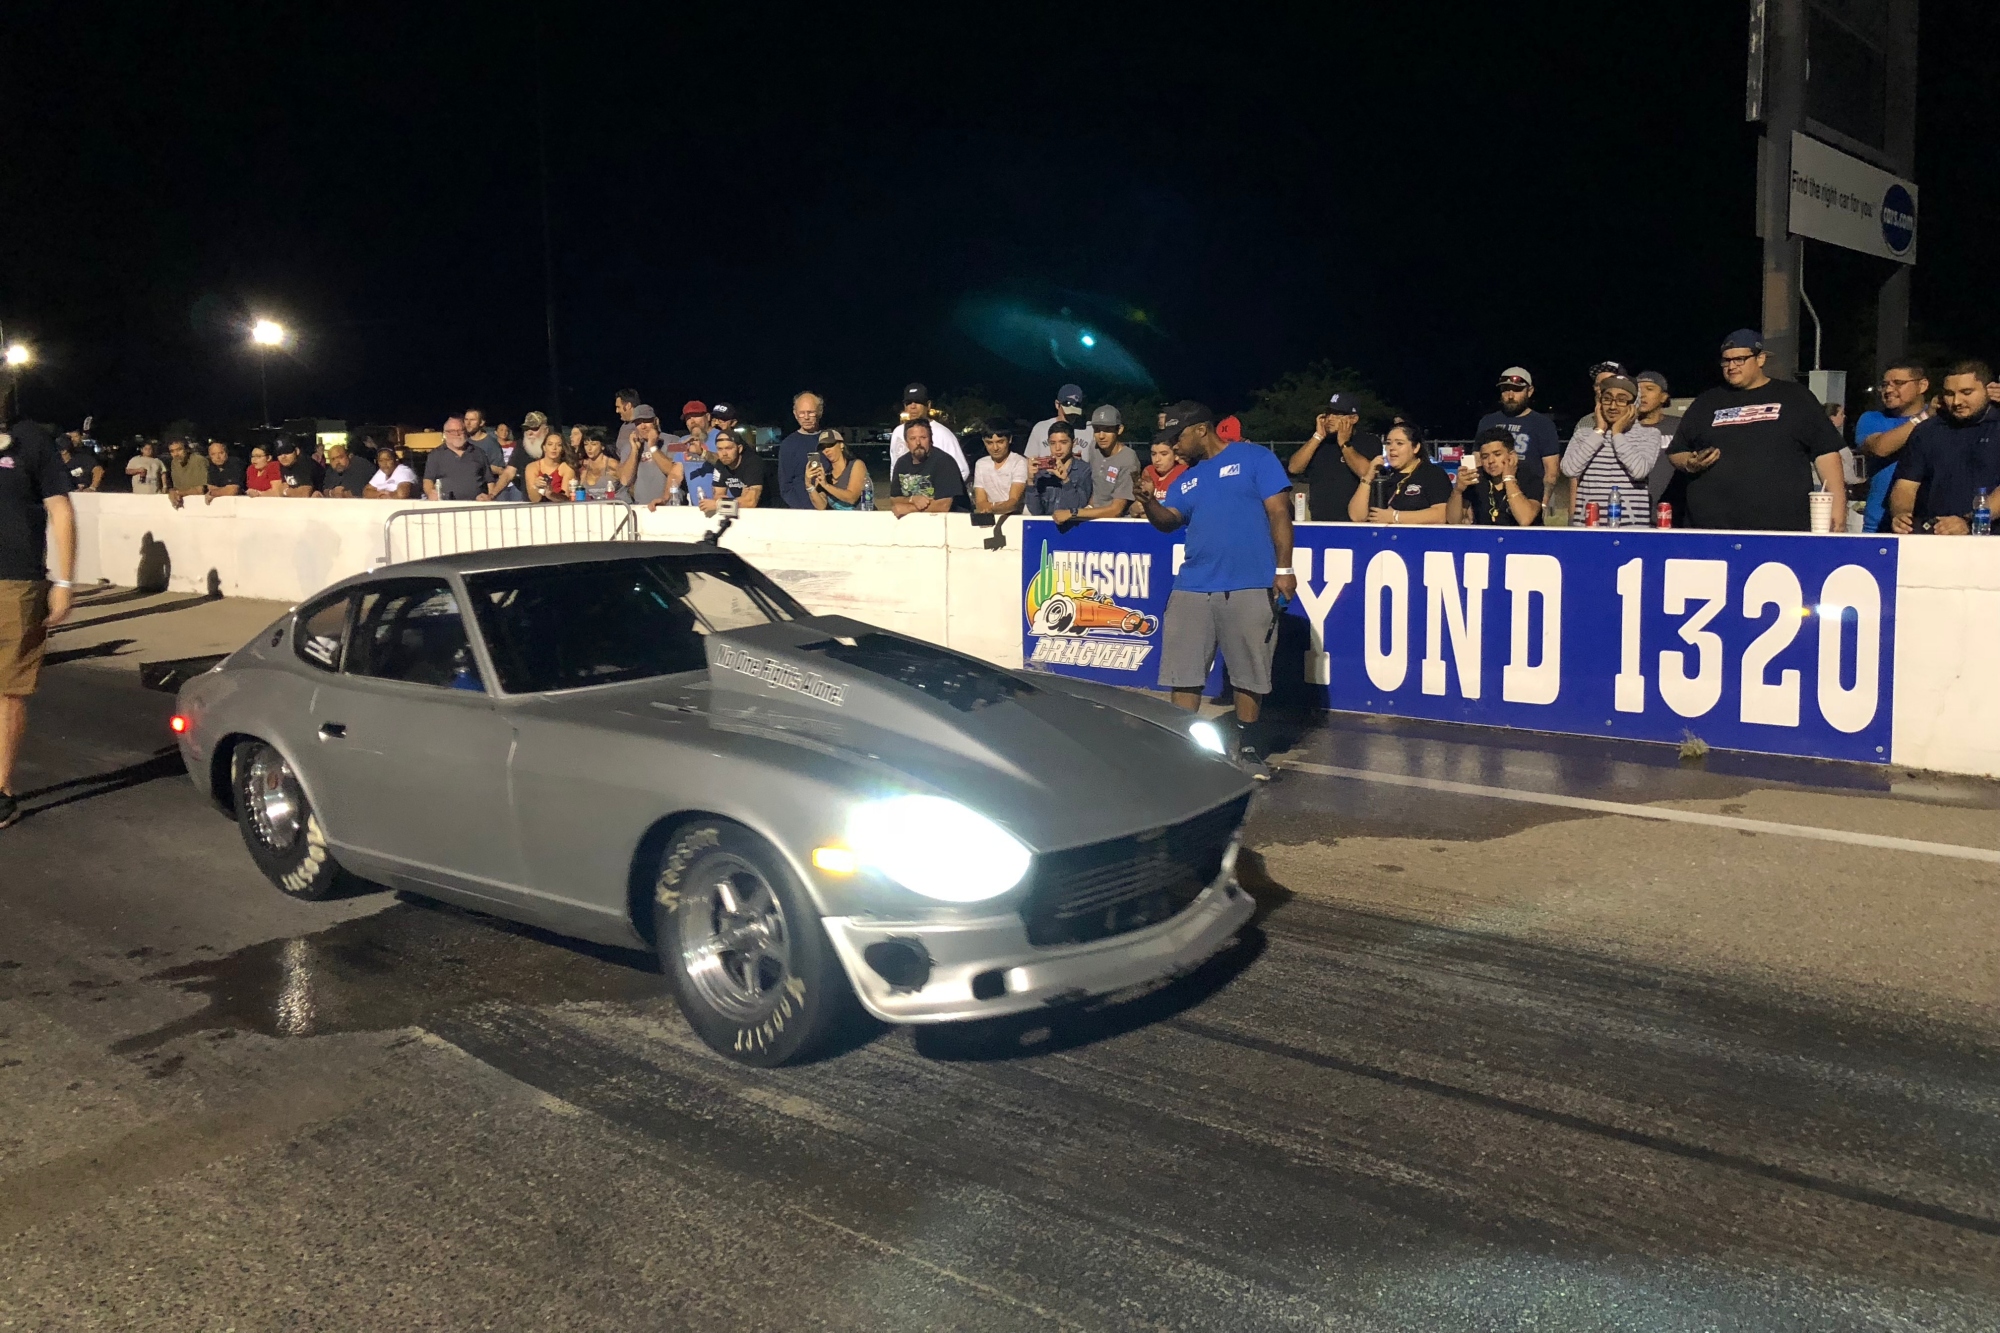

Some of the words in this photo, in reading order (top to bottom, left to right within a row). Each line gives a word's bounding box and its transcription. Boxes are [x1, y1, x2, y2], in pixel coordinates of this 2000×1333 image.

[1791, 170, 1808, 195] Find
[1809, 178, 1820, 199] the
[1821, 183, 1837, 208] right
[1839, 193, 1850, 209] car
[1850, 192, 1860, 213] for
[1053, 550, 1152, 599] TUCSON
[713, 643, 737, 669] No
[733, 649, 763, 677] One
[1031, 637, 1154, 672] DRAGWAY
[1172, 544, 1562, 705] YOND
[1614, 557, 1882, 734] 1320
